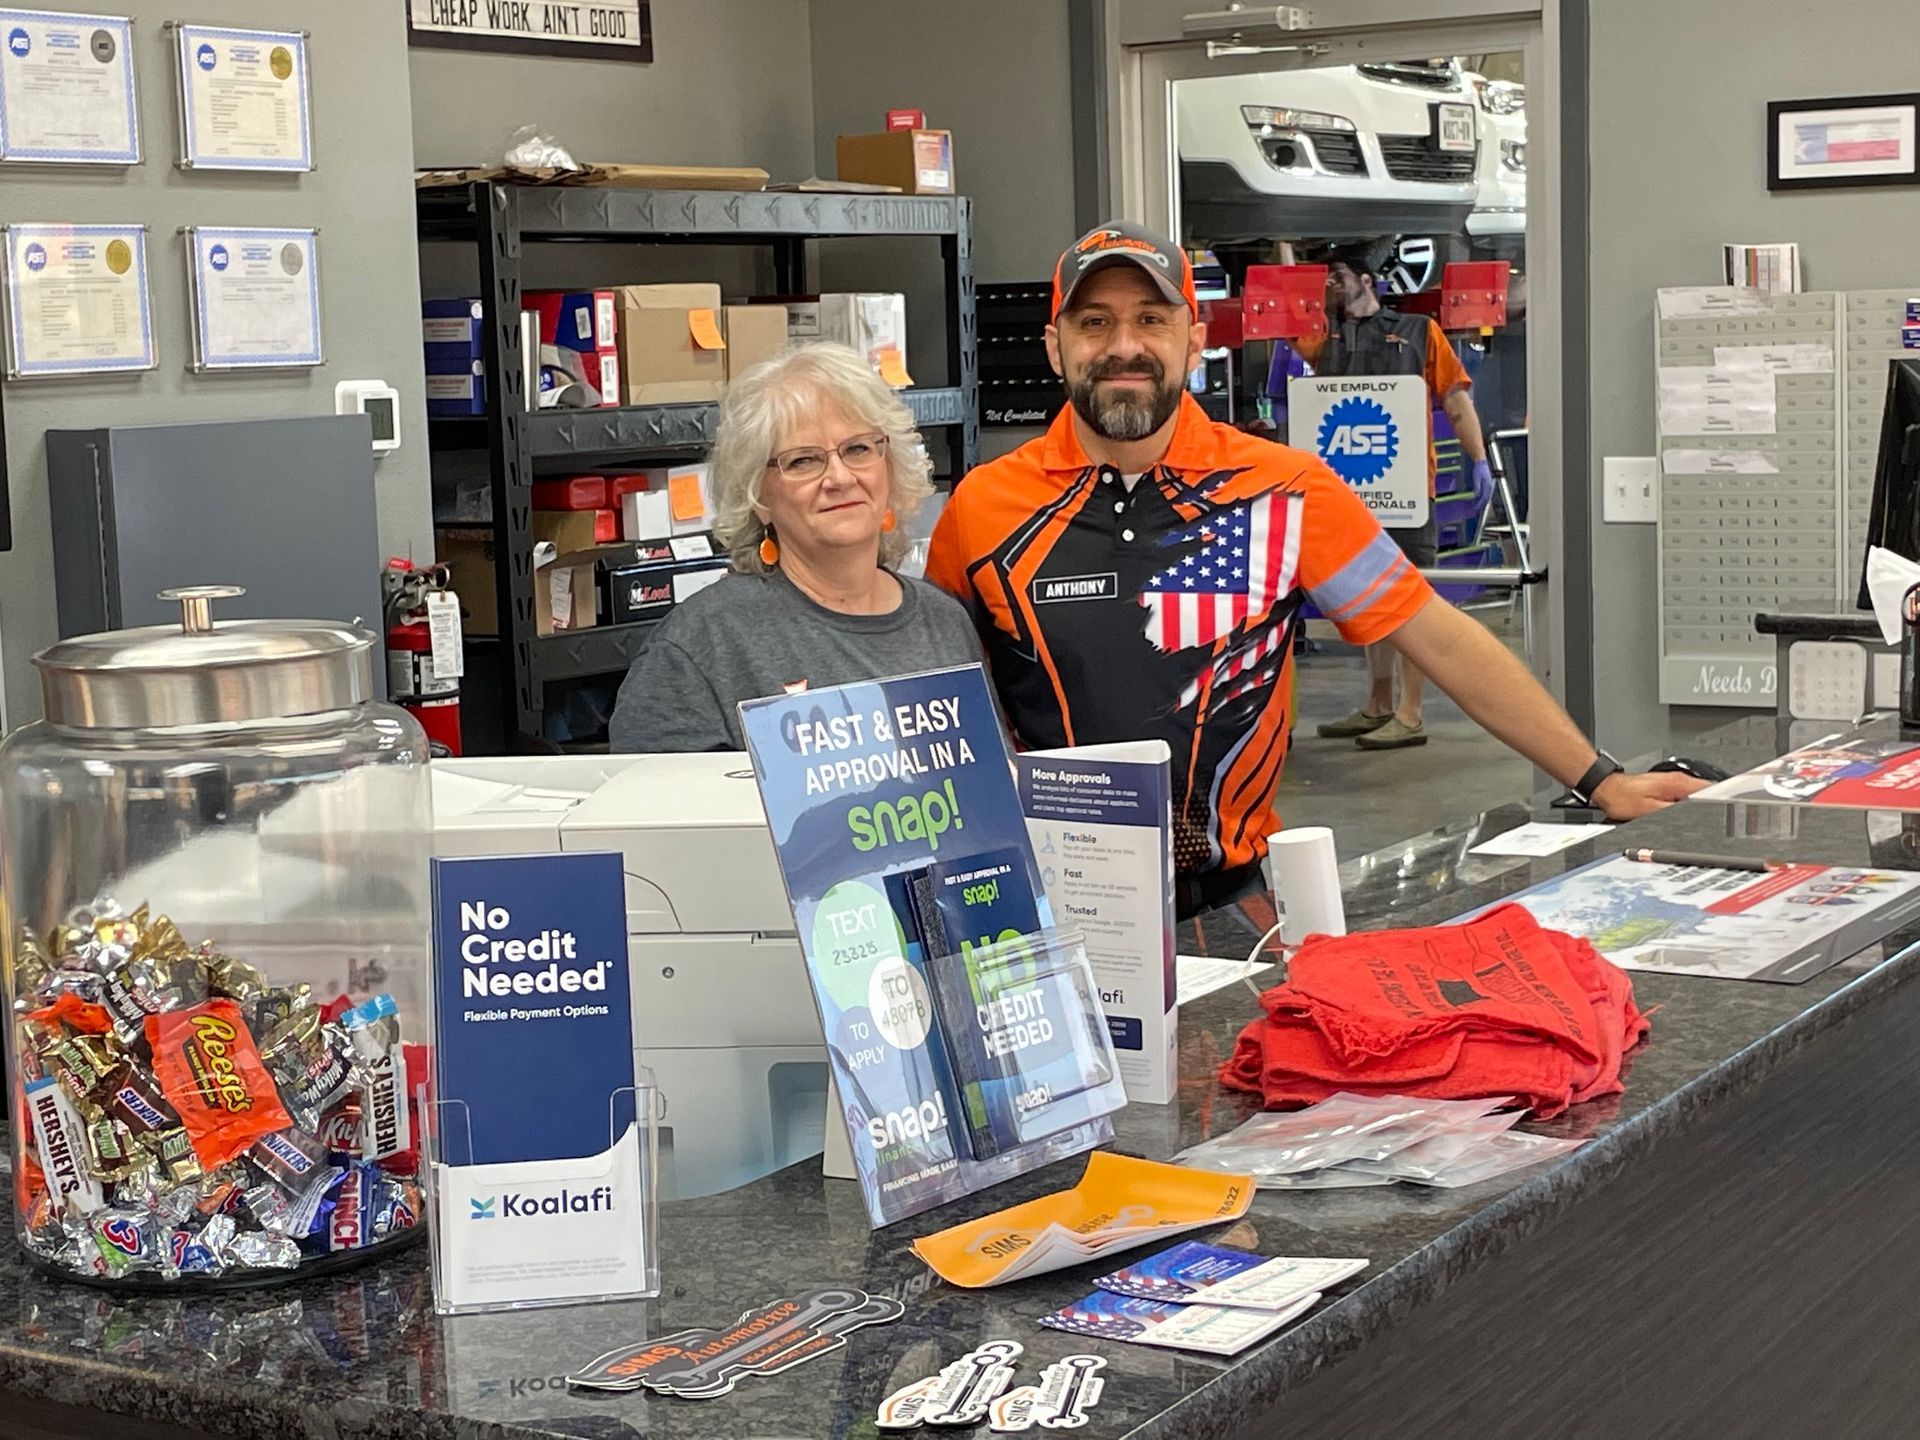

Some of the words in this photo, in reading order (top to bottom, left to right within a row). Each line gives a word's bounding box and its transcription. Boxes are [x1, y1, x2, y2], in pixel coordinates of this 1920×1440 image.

[431, 0, 477, 27] CHEAP
[488, 1, 530, 31] WORK
[543, 6, 580, 35] AIN'T
[590, 9, 626, 38] GOOD
[1316, 383, 1338, 393] WE
[1340, 382, 1398, 392] EMPLOY
[1326, 424, 1388, 456] ASE
[1354, 491, 1393, 500] IFIED
[1046, 579, 1106, 598] ANTHONY
[1693, 665, 1752, 694] Needs
[796, 713, 864, 757] FAST
[872, 709, 894, 742] &
[895, 696, 962, 738] EASY
[806, 747, 928, 795] APPROVAL
[929, 741, 952, 770] IN
[960, 738, 976, 764] A
[1032, 768, 1056, 781] More
[1058, 770, 1111, 785] Approvals
[848, 778, 963, 851] snap!
[1063, 832, 1097, 844] Flexible
[1064, 868, 1083, 878] Fast
[963, 878, 1000, 907] snap!
[461, 900, 510, 931] No
[825, 903, 877, 938] TEXT
[1065, 904, 1097, 916] Trusted
[461, 930, 577, 965] Credit
[882, 975, 909, 999] TO
[464, 1009, 508, 1022] Flexible
[510, 1007, 561, 1021] Payment
[563, 1005, 609, 1018] Options
[849, 1021, 869, 1040] TO
[189, 1014, 254, 1114] Reese's
[848, 1046, 886, 1071] APPLY
[371, 1054, 398, 1156] HERSHEYS
[867, 1090, 948, 1149] snap!
[36, 1094, 80, 1194] HERSHEY'S
[503, 1187, 613, 1217] Koalafi
[981, 1233, 1032, 1260] SIMS
[681, 1299, 801, 1366] Automotive
[607, 1345, 684, 1378] SIMS
[895, 1396, 927, 1420] SIMS
[1007, 1398, 1034, 1423] SIMS
